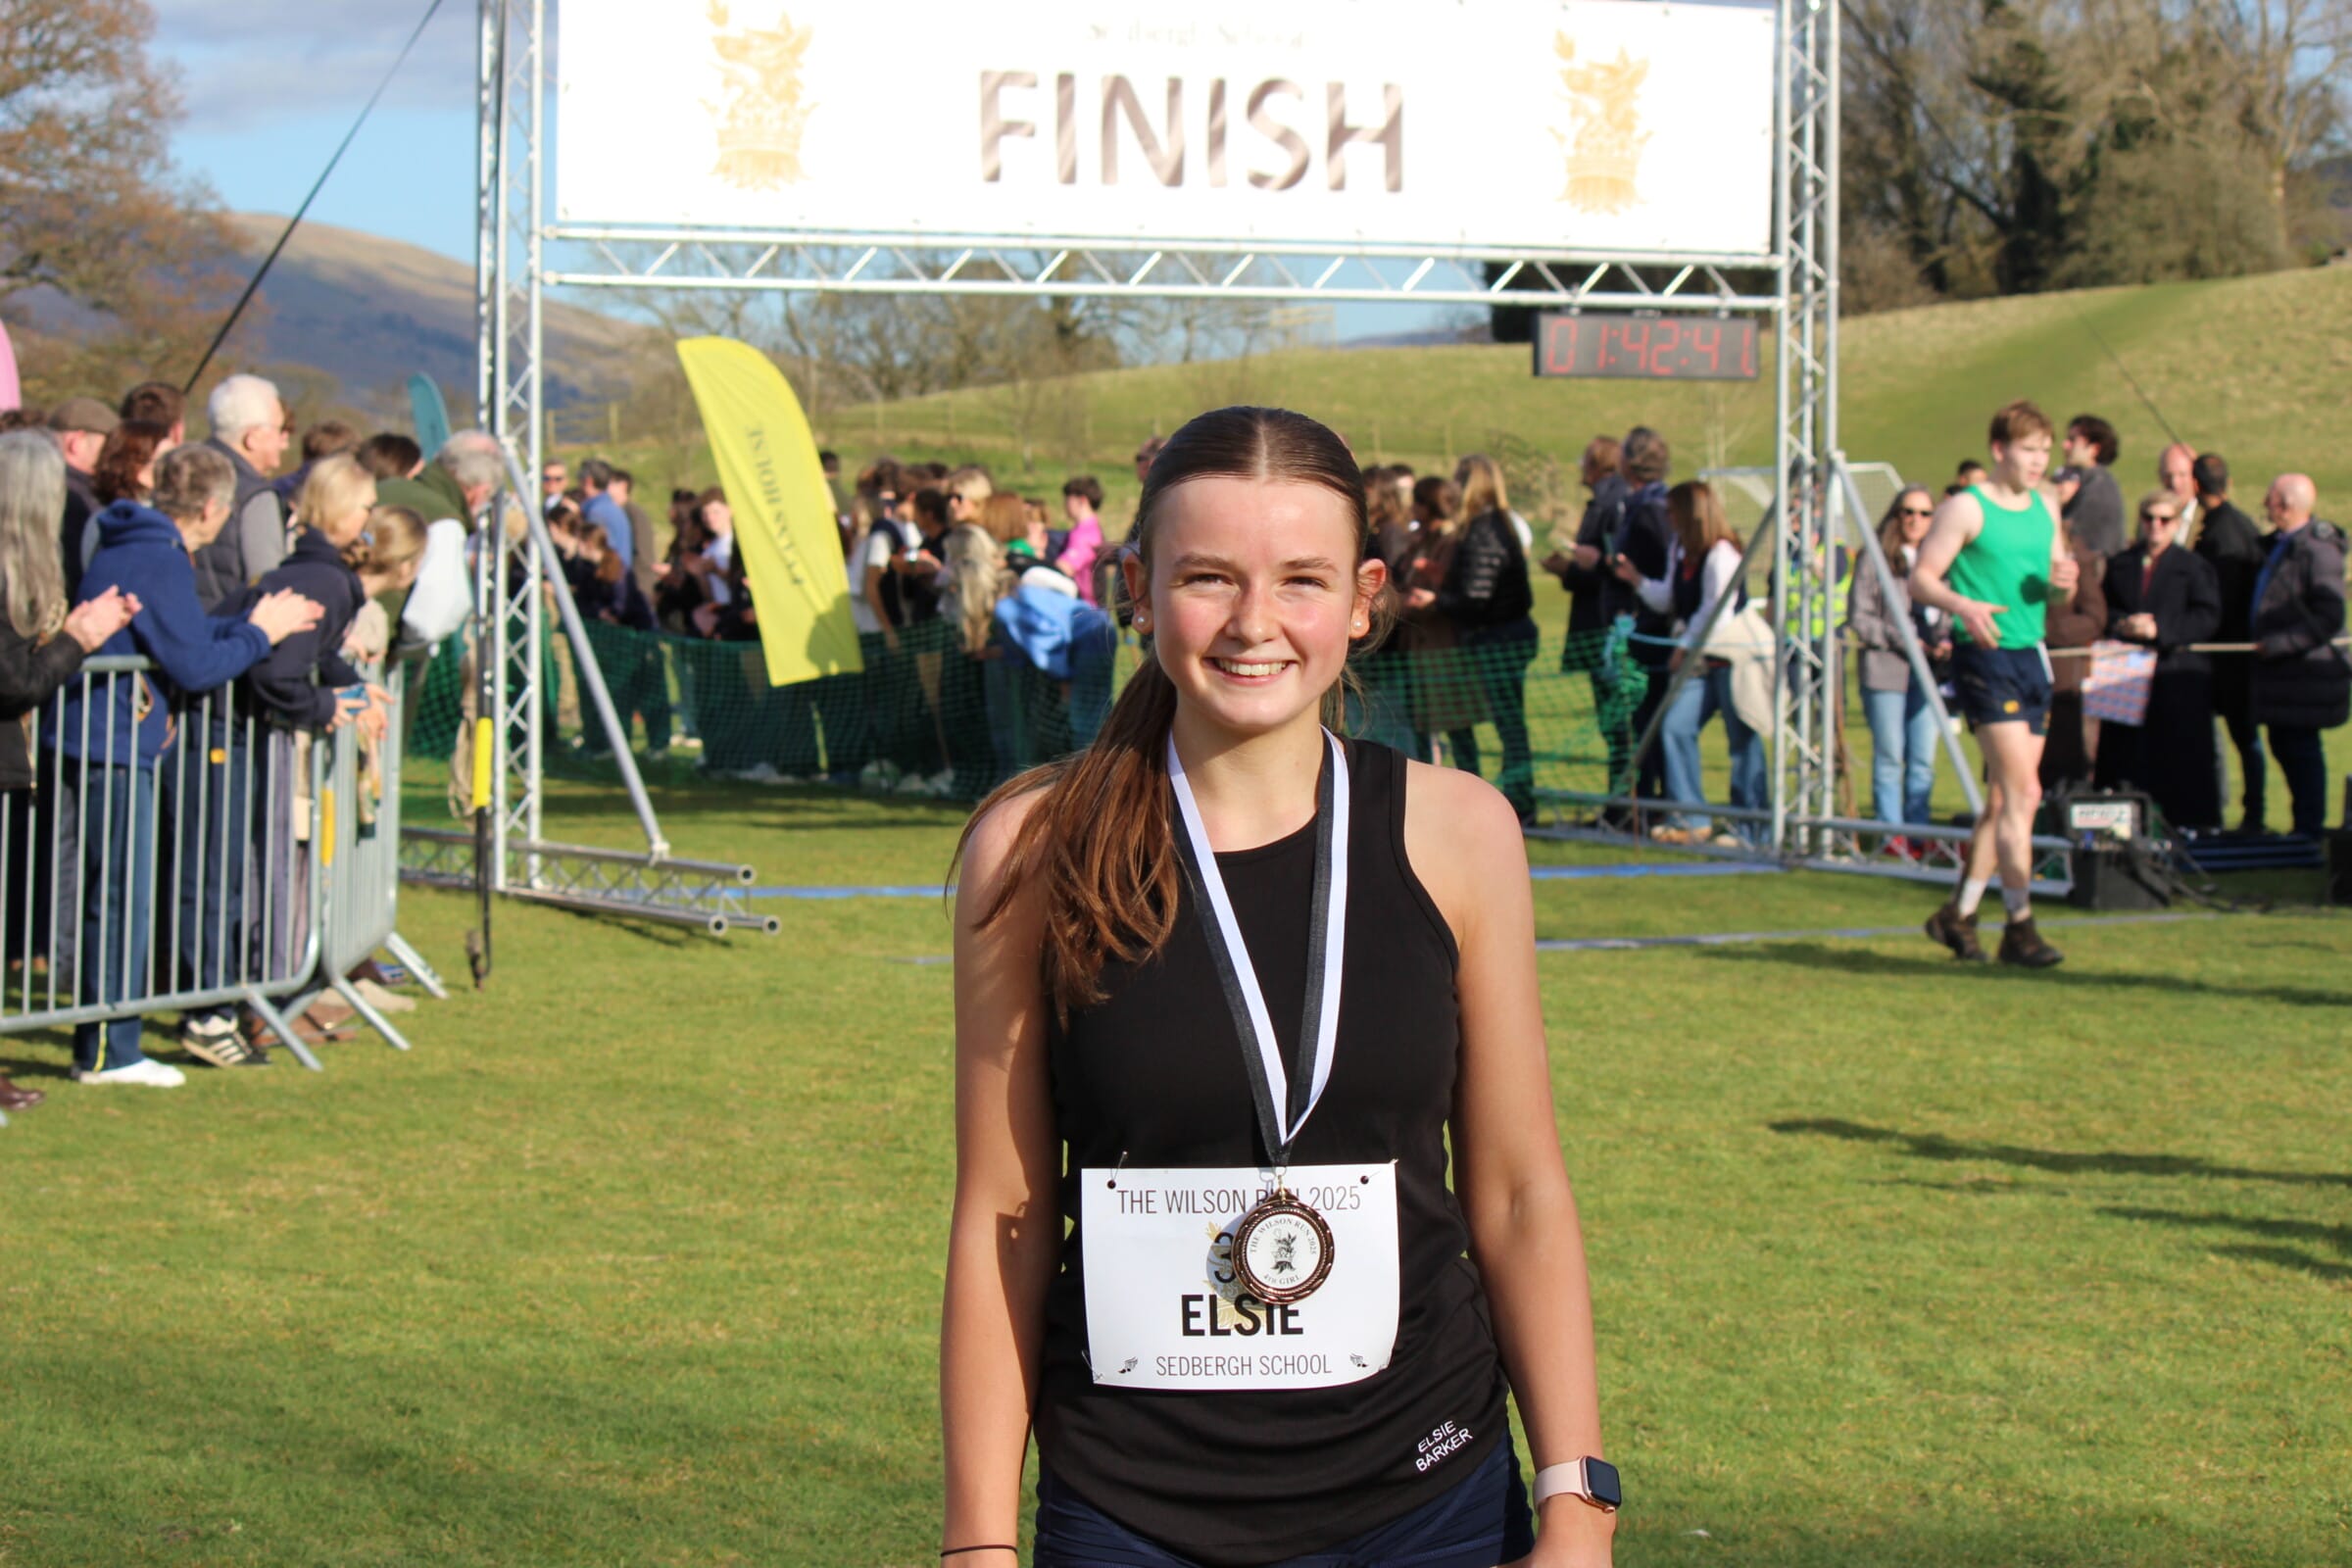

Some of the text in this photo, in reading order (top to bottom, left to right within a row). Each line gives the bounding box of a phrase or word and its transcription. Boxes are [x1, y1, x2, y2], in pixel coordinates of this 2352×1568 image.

[981, 70, 1404, 192] FINISH
[1117, 1190, 1157, 1214] THE
[1164, 1189, 1247, 1214] WILSON
[1309, 1186, 1361, 1211] 2025
[1250, 1217, 1317, 1254] THE WILSON RUN 2025
[1279, 1274, 1301, 1285] GIRL
[1182, 1294, 1304, 1337] ELSIE
[1155, 1354, 1333, 1377] SEDBERGH SCHOOL
[1415, 1428, 1473, 1472] BARKER
[1418, 1420, 1456, 1452] ELSIE
